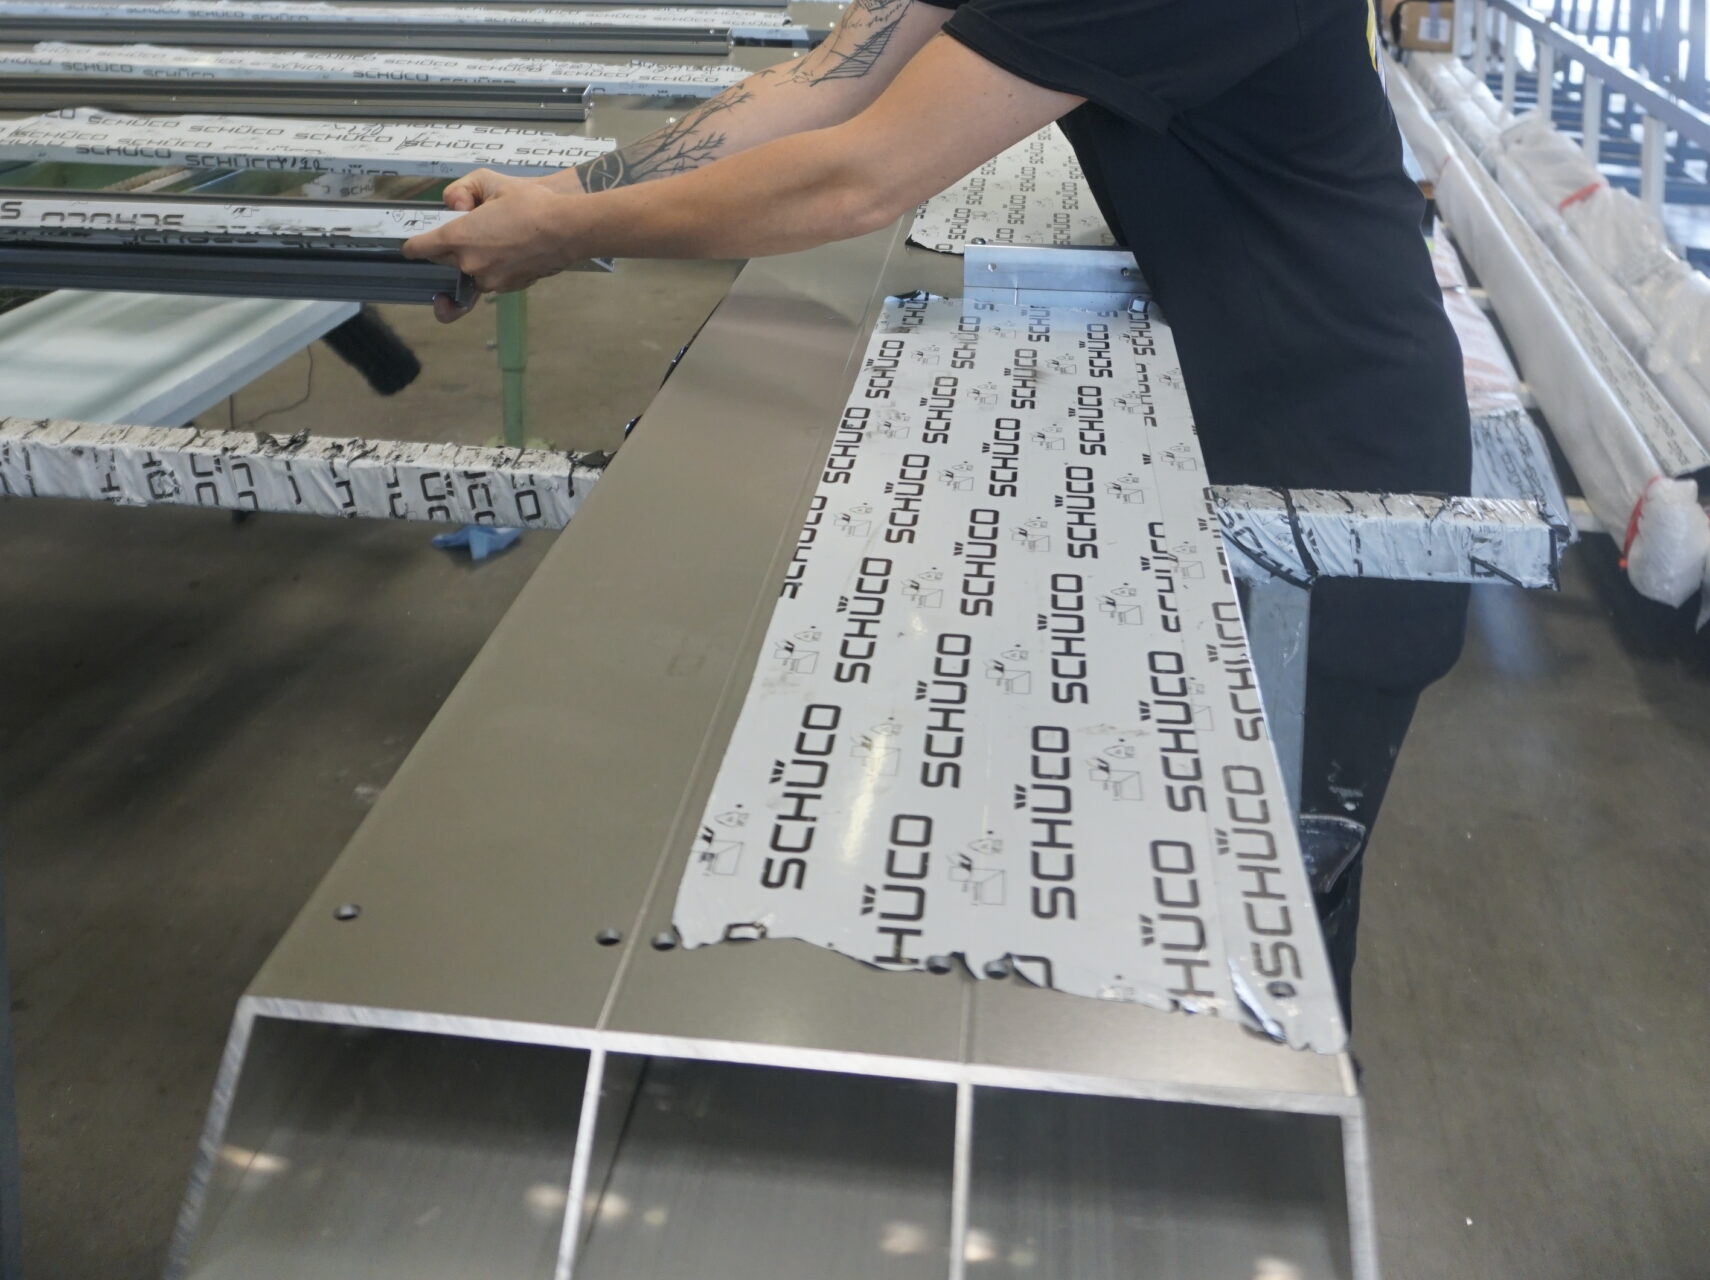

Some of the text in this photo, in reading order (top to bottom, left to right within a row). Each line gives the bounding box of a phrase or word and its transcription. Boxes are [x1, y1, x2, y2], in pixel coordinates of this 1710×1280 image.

[865, 339, 905, 400] SCHÜCO
[920, 375, 959, 445] SCHÜCO
[1004, 348, 1038, 410] SCHÜCO
[1078, 323, 1113, 379] SCHÜCO
[982, 417, 1021, 498] SCHÜCO
[1068, 385, 1107, 457] SCHÜCO
[884, 453, 930, 545] SCHÜCO
[1054, 466, 1099, 560] SCHÜCO
[834, 556, 893, 685] SCHÜCO
[953, 507, 1000, 617] SCHÜCO
[1037, 572, 1089, 705] SCHÜCO
[914, 632, 972, 789] SCHÜCO
[1138, 650, 1207, 814] SCHÜCO
[760, 703, 842, 891] SCHÜCO
[1014, 724, 1077, 921] SCHÜCO
[860, 813, 933, 967] HÜCO
[1138, 839, 1216, 999] HÜCO
[1214, 764, 1303, 981] SCHÜCO
